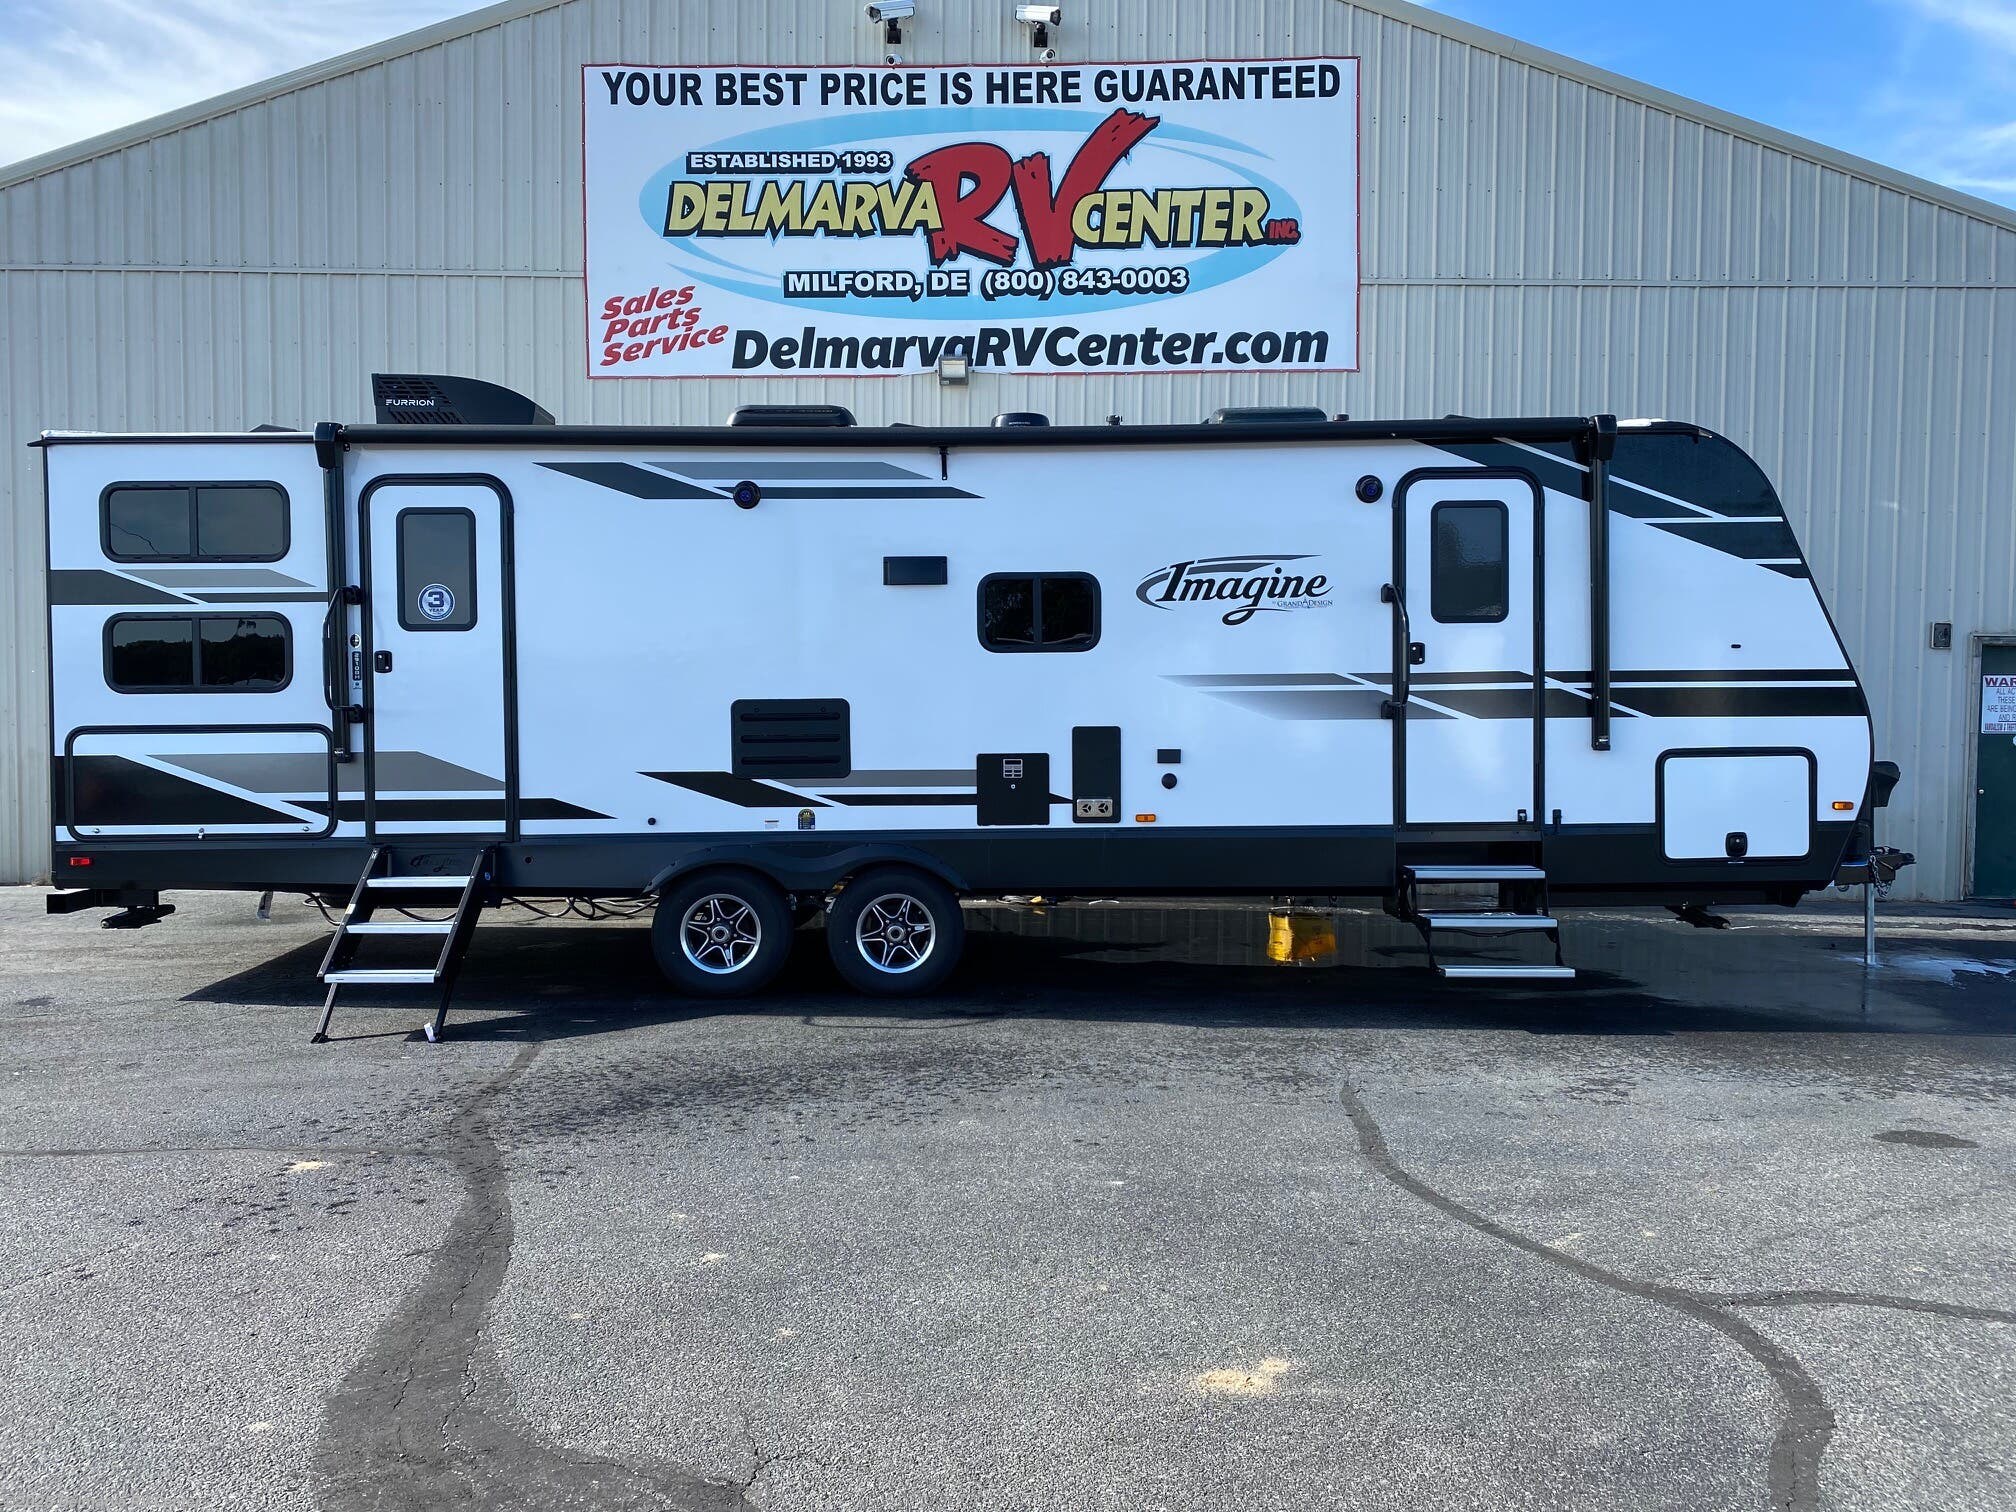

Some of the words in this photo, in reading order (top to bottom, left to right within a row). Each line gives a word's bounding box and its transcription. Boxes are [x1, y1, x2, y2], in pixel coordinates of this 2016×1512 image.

[602, 72, 703, 106] YOUR
[715, 73, 807, 106] BEST
[820, 73, 926, 106] PRICE
[940, 72, 973, 104] IS
[986, 71, 1081, 104] HERE
[1094, 64, 1340, 103] GUARANTEED
[690, 153, 835, 168] ESTABLISHED
[842, 153, 891, 168] 1993
[664, 180, 945, 240] DELMARVA
[905, 108, 1160, 270] RV
[1070, 188, 1270, 247] CENTER
[788, 272, 922, 295] MILFORD,
[930, 271, 968, 291] DE
[985, 271, 1052, 296] (800)
[1062, 269, 1188, 290] 843-0003
[601, 285, 695, 320] Sales
[603, 306, 702, 343] Parts
[600, 324, 728, 367] Service
[732, 326, 1329, 369] DelmarvaRVCenter.com
[427, 591, 445, 608] 3
[1154, 560, 1334, 626] Imagine
